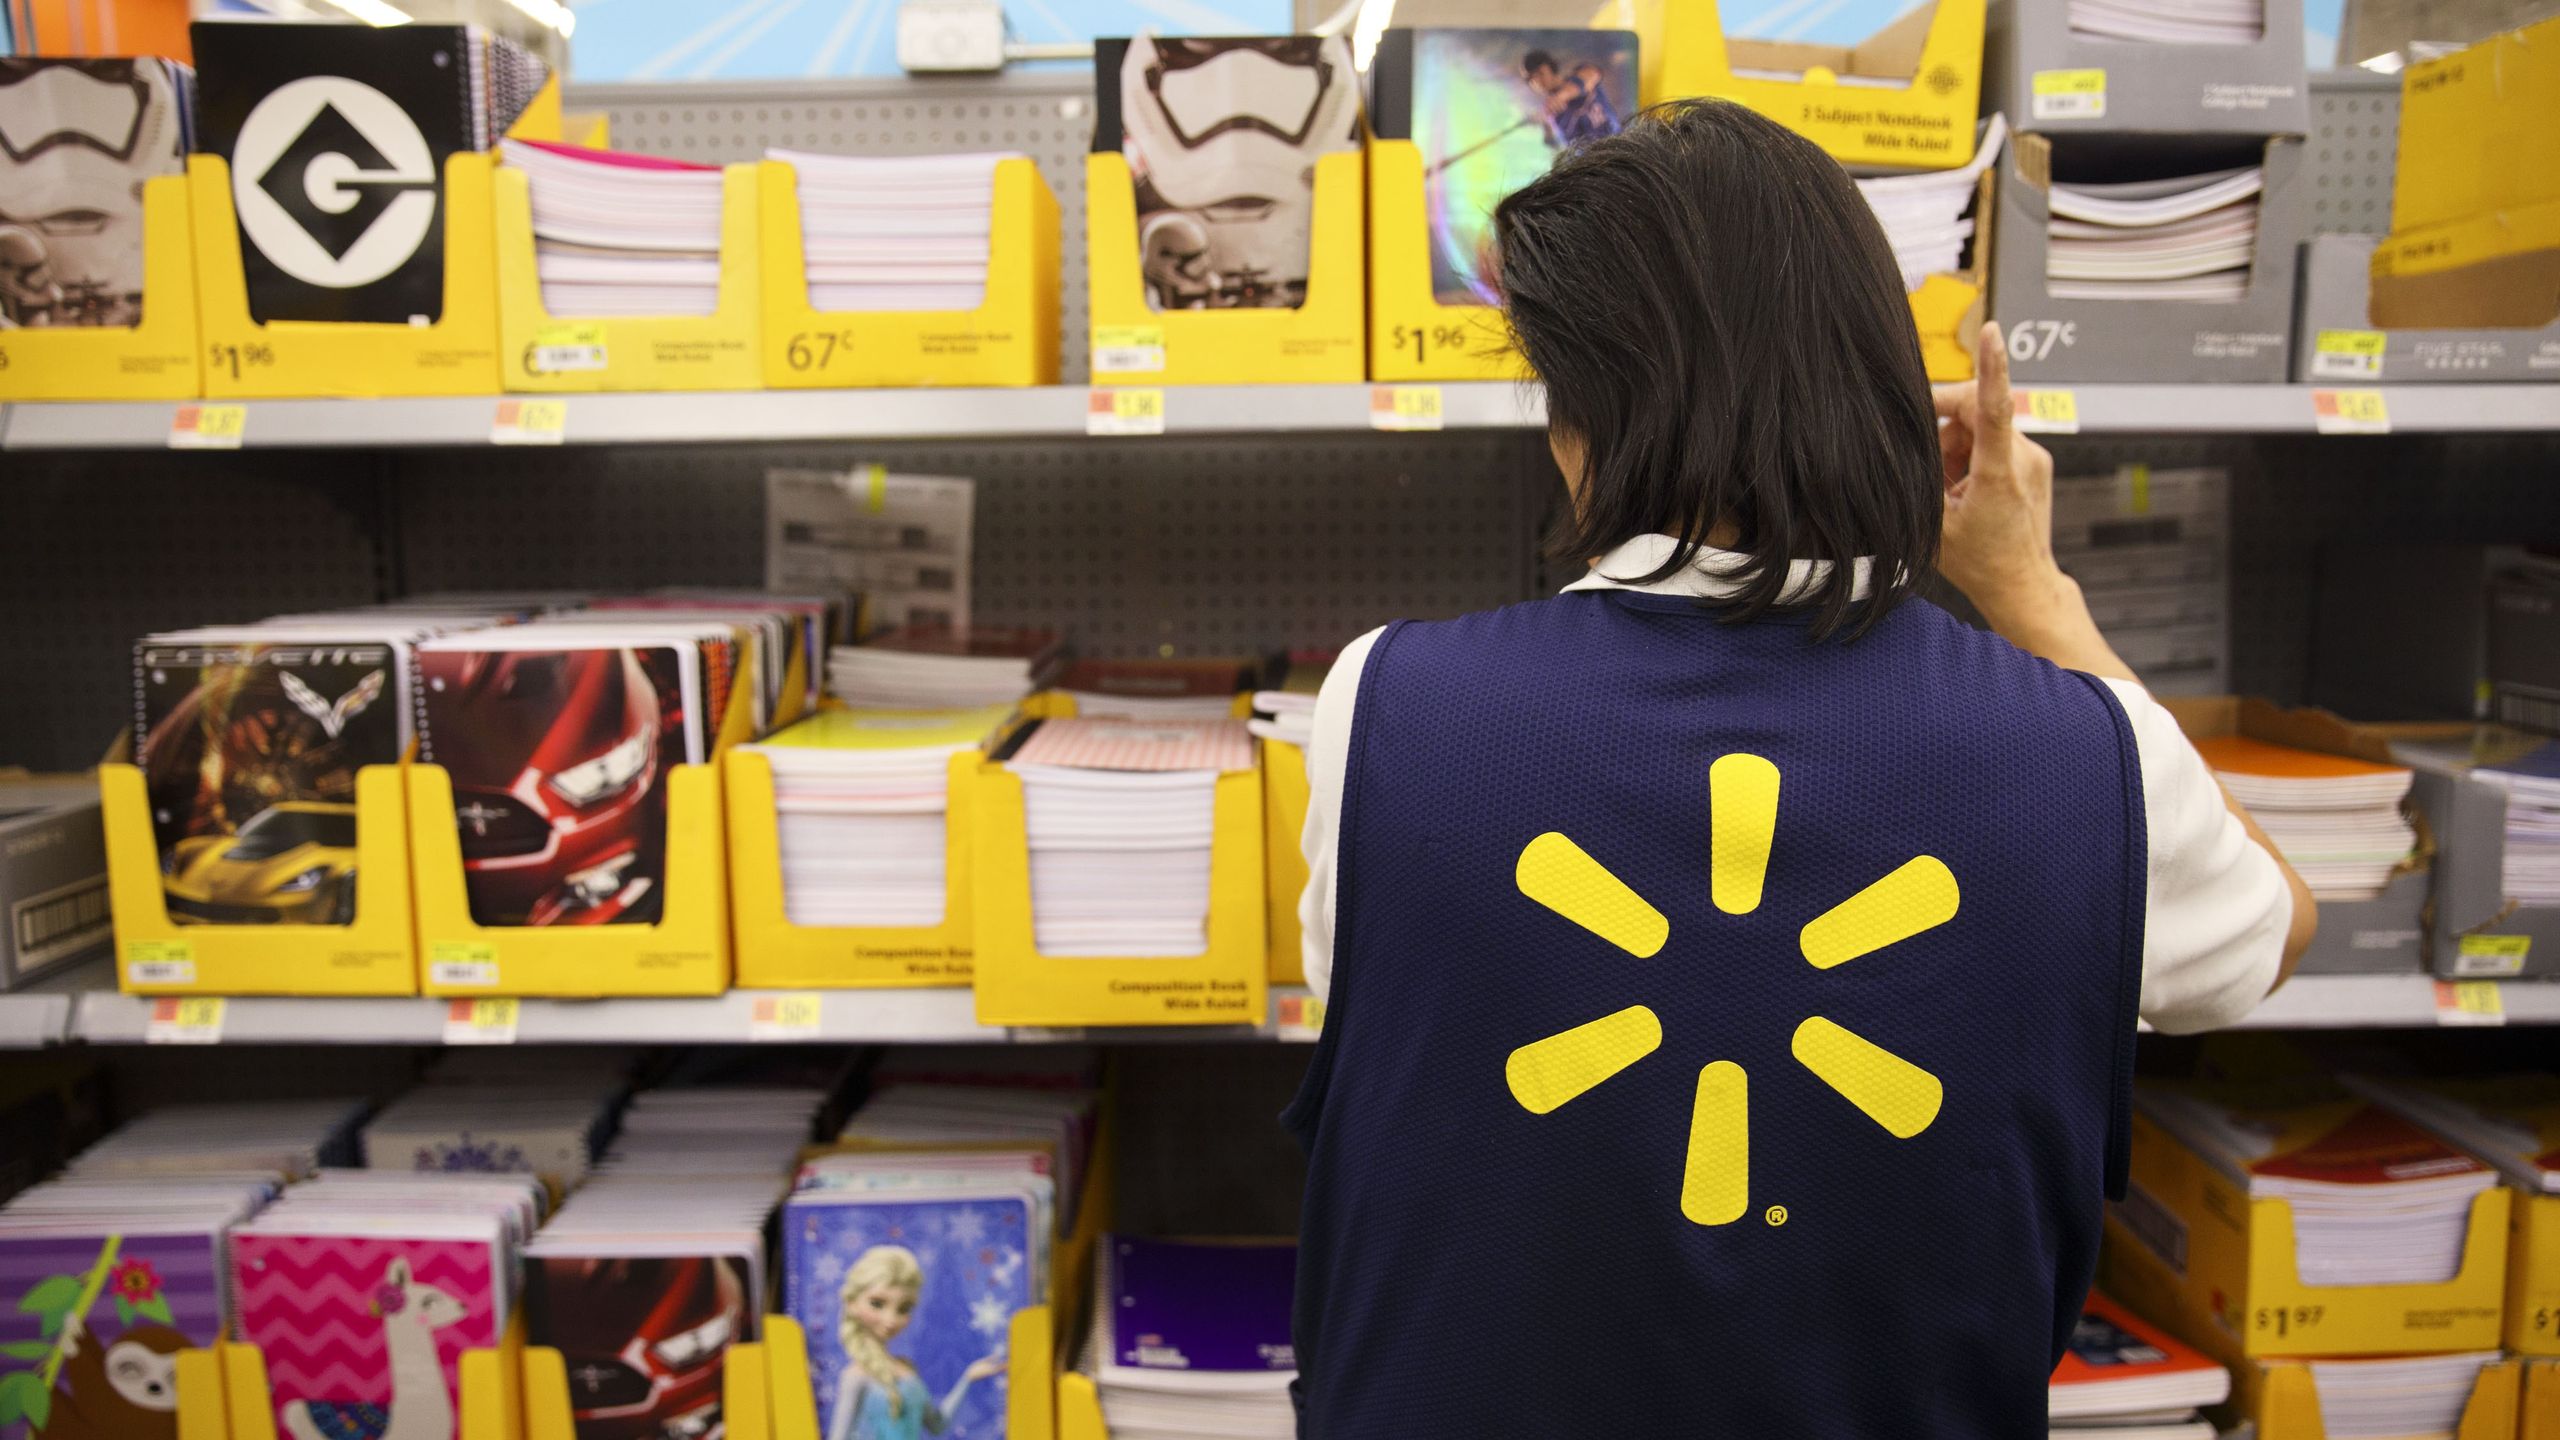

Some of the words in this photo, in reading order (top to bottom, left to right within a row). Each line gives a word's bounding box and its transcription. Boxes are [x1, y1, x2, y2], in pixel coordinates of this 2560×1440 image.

[1815, 107, 1872, 127] Subject
[1877, 111, 1952, 130] Notebook
[1863, 133, 1902, 149] Wide
[1906, 135, 1952, 151] Ruled
[2008, 319, 2078, 361] 67¢
[787, 330, 853, 371] 67¢
[854, 946, 943, 961] Composition
[907, 964, 940, 976] Wide
[1108, 979, 1204, 996] Composition
[1209, 978, 1248, 993] Book
[1165, 996, 1201, 1010] Wide
[1206, 995, 1249, 1010] Ruled
